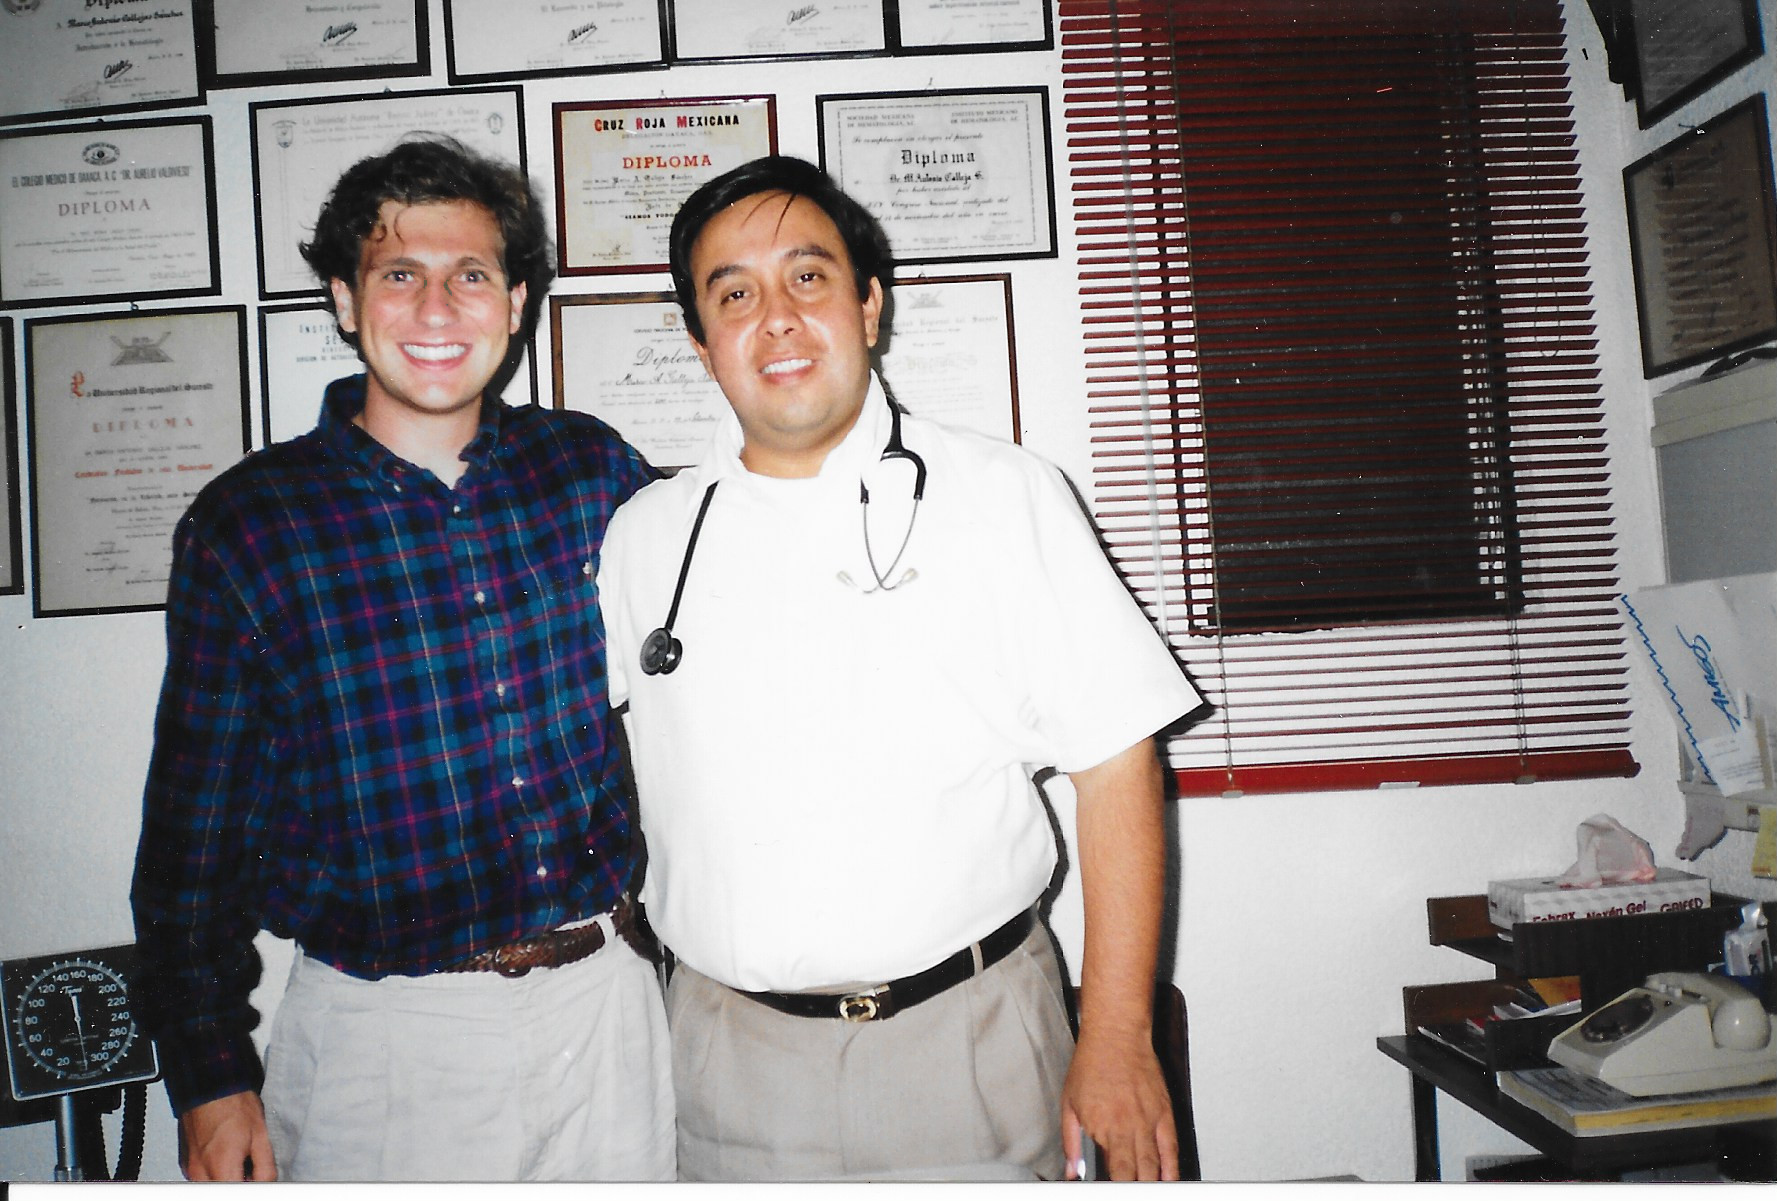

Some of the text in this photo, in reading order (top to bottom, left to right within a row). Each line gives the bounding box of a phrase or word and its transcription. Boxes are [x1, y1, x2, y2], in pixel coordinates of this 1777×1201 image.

[594, 114, 740, 132] CRUZ ROJA MEXICANA
[623, 154, 712, 170] DIPLOMA
[901, 149, 976, 168] Diploma
[917, 173, 942, 183] Antonio
[944, 171, 971, 185] Calleja
[58, 198, 151, 217] DIPLOMA
[633, 346, 702, 371] Diplom
[1626, 899, 1647, 915] Gel
[53, 973, 69, 982] 140
[70, 970, 87, 979] 160
[88, 973, 104, 982] 180
[38, 984, 55, 993] 120
[99, 984, 117, 994] 200
[29, 998, 45, 1008] 100
[107, 996, 126, 1007] 220
[25, 1016, 38, 1025] 80
[111, 1011, 130, 1022] 240
[109, 1027, 128, 1037] 260
[29, 1033, 42, 1043] 60
[101, 1039, 120, 1050] 280
[41, 1048, 53, 1057] 40
[90, 1051, 109, 1062] 300
[57, 1057, 70, 1066] 20
